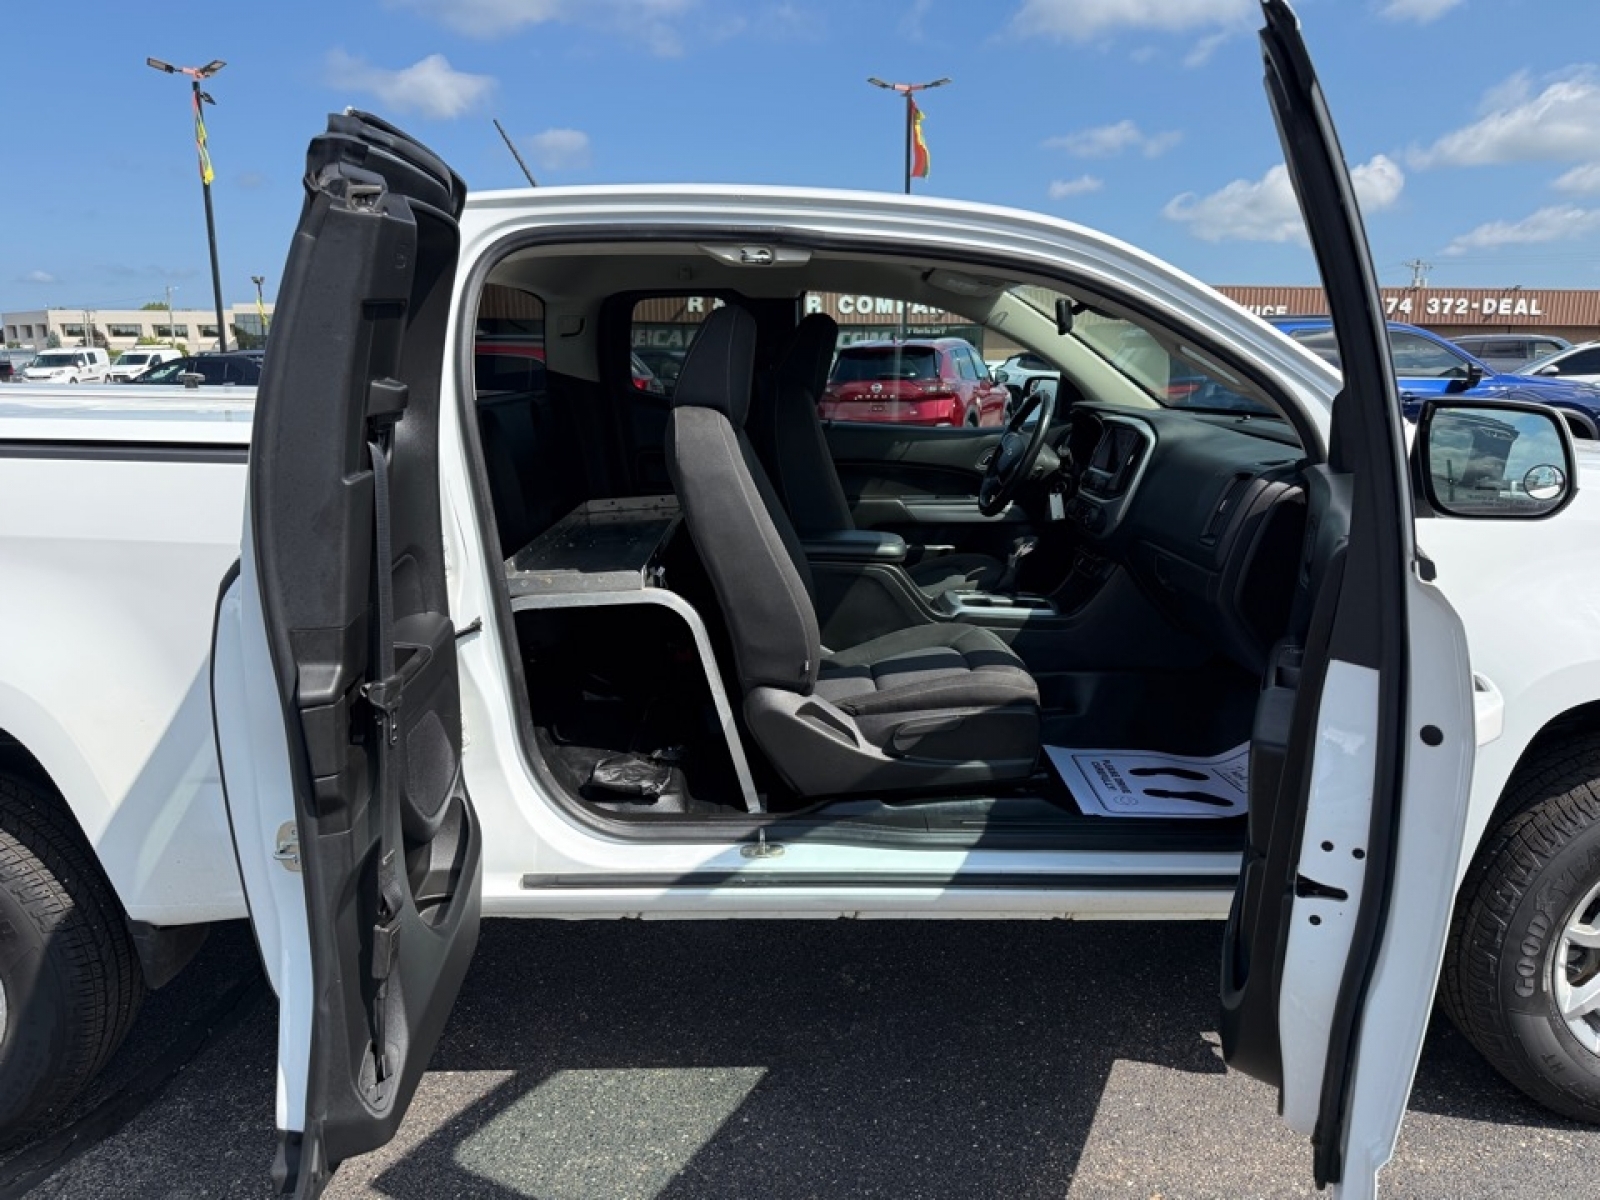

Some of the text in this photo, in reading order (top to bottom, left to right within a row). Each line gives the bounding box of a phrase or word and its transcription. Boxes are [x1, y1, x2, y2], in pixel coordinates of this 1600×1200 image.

[687, 296, 704, 313] R
[806, 295, 822, 313] R
[1384, 297, 1542, 316] 74 372-DEAL
